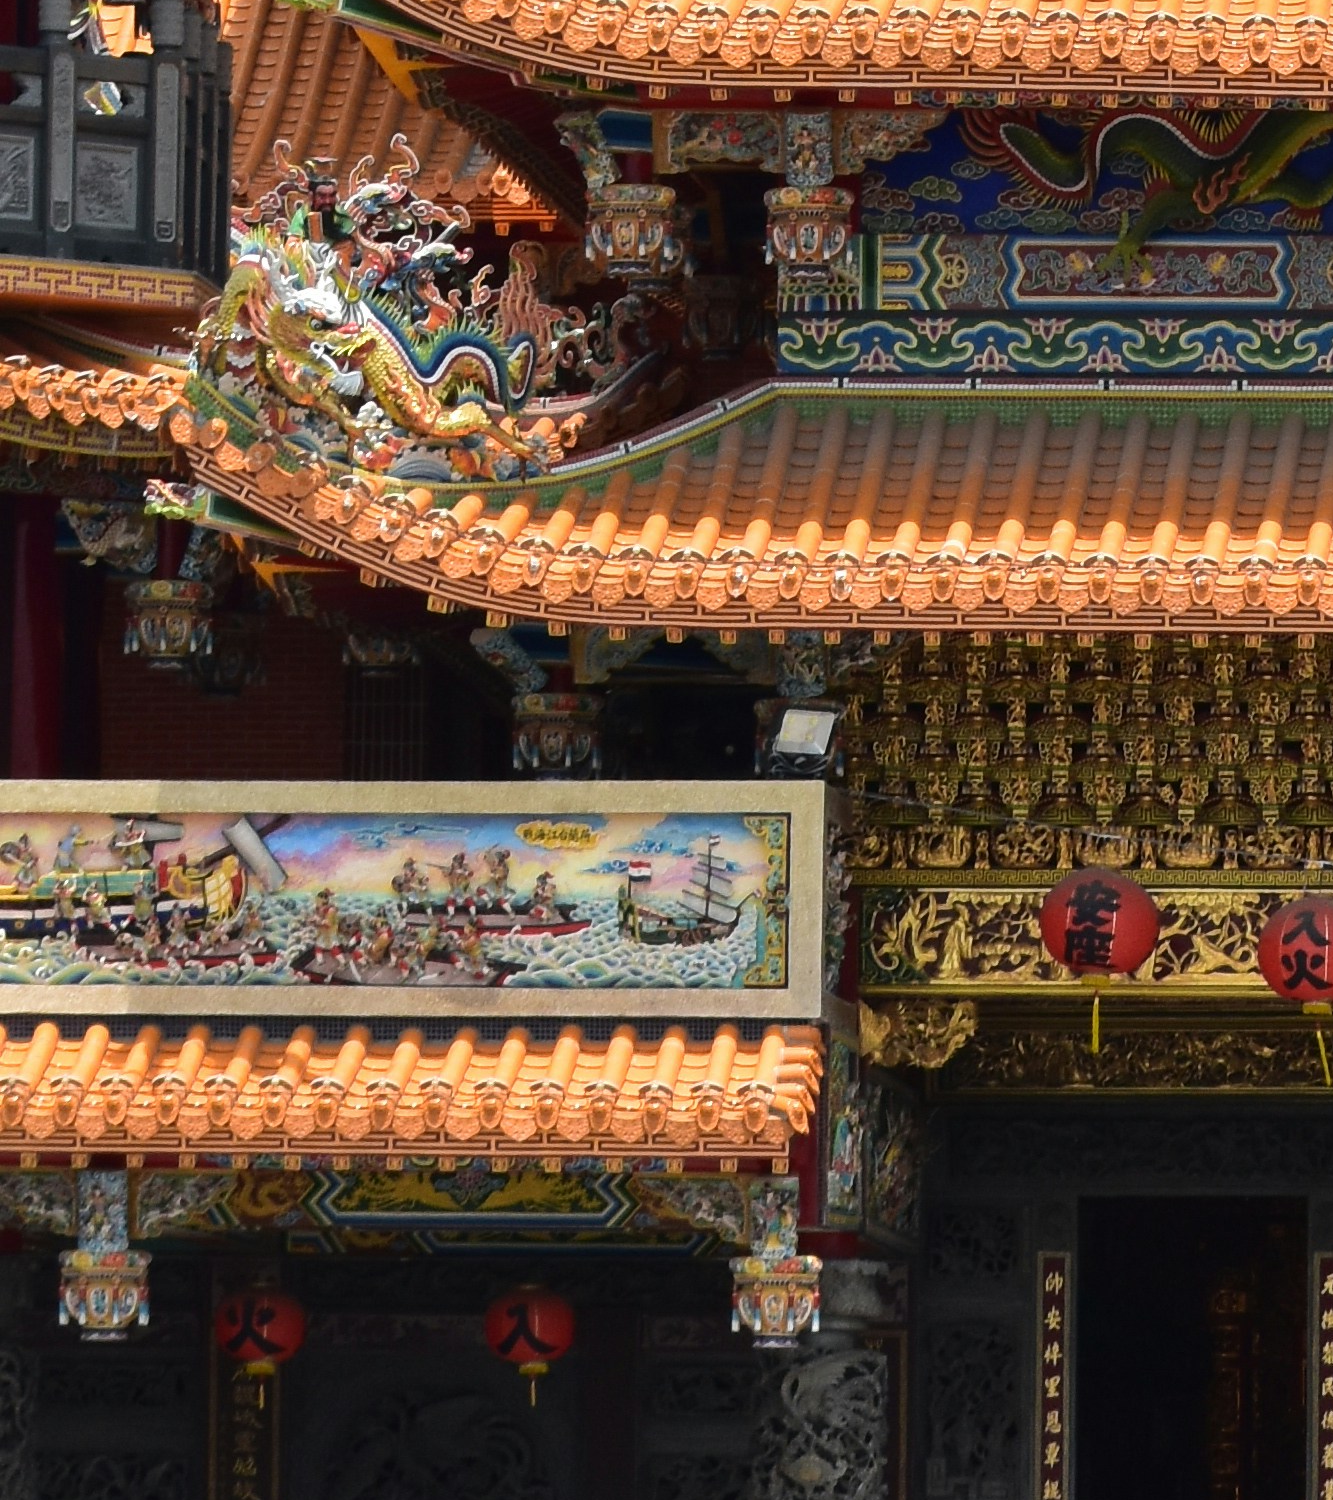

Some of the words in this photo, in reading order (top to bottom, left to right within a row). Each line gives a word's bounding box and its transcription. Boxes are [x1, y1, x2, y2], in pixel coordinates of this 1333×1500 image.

[1064, 879, 1122, 969] 安座
[1281, 911, 1333, 991] 入火
[223, 1303, 287, 1354] 火
[496, 1305, 559, 1356] 入
